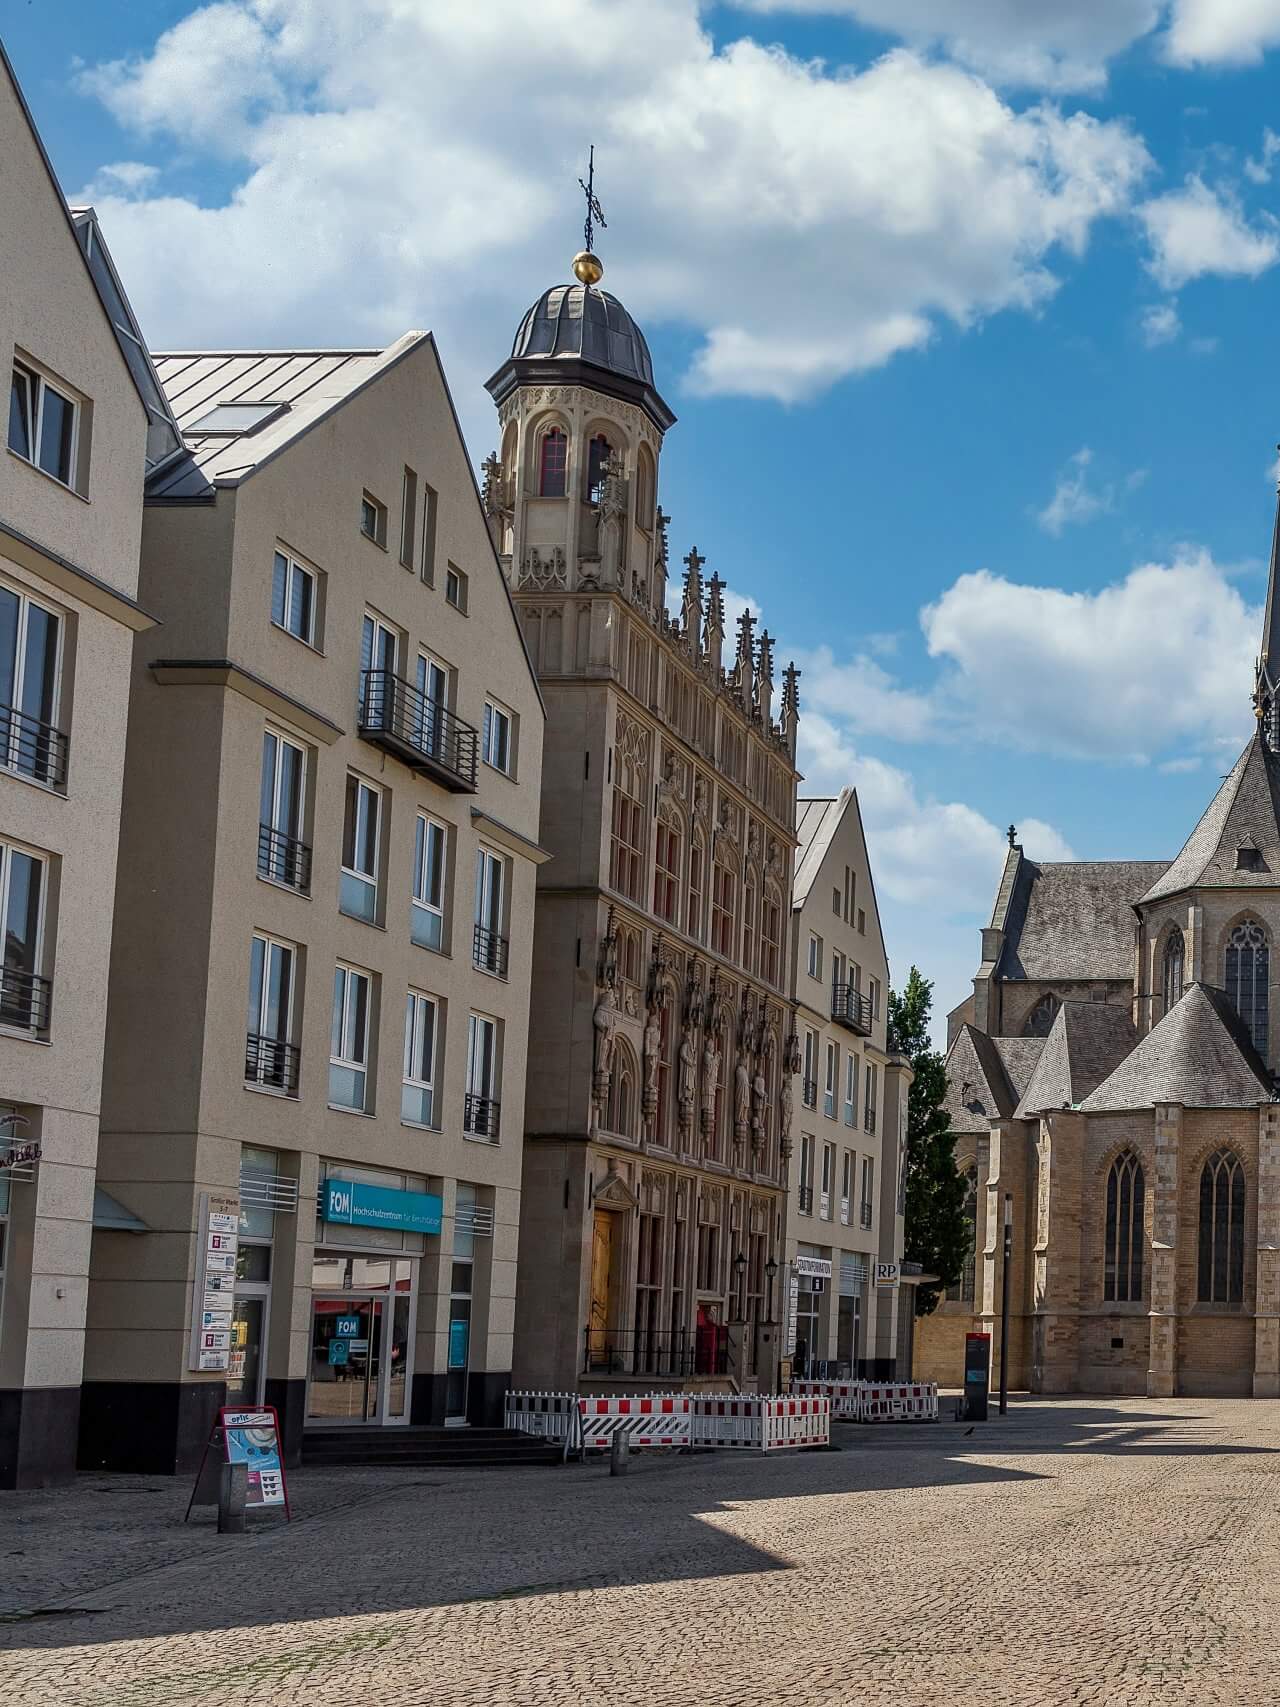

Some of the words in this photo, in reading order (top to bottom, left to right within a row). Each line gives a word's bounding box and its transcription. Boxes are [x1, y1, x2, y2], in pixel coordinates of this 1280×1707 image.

[330, 1191, 349, 1213] FOM
[878, 1264, 896, 1278] RP
[338, 1321, 357, 1333] FOM
